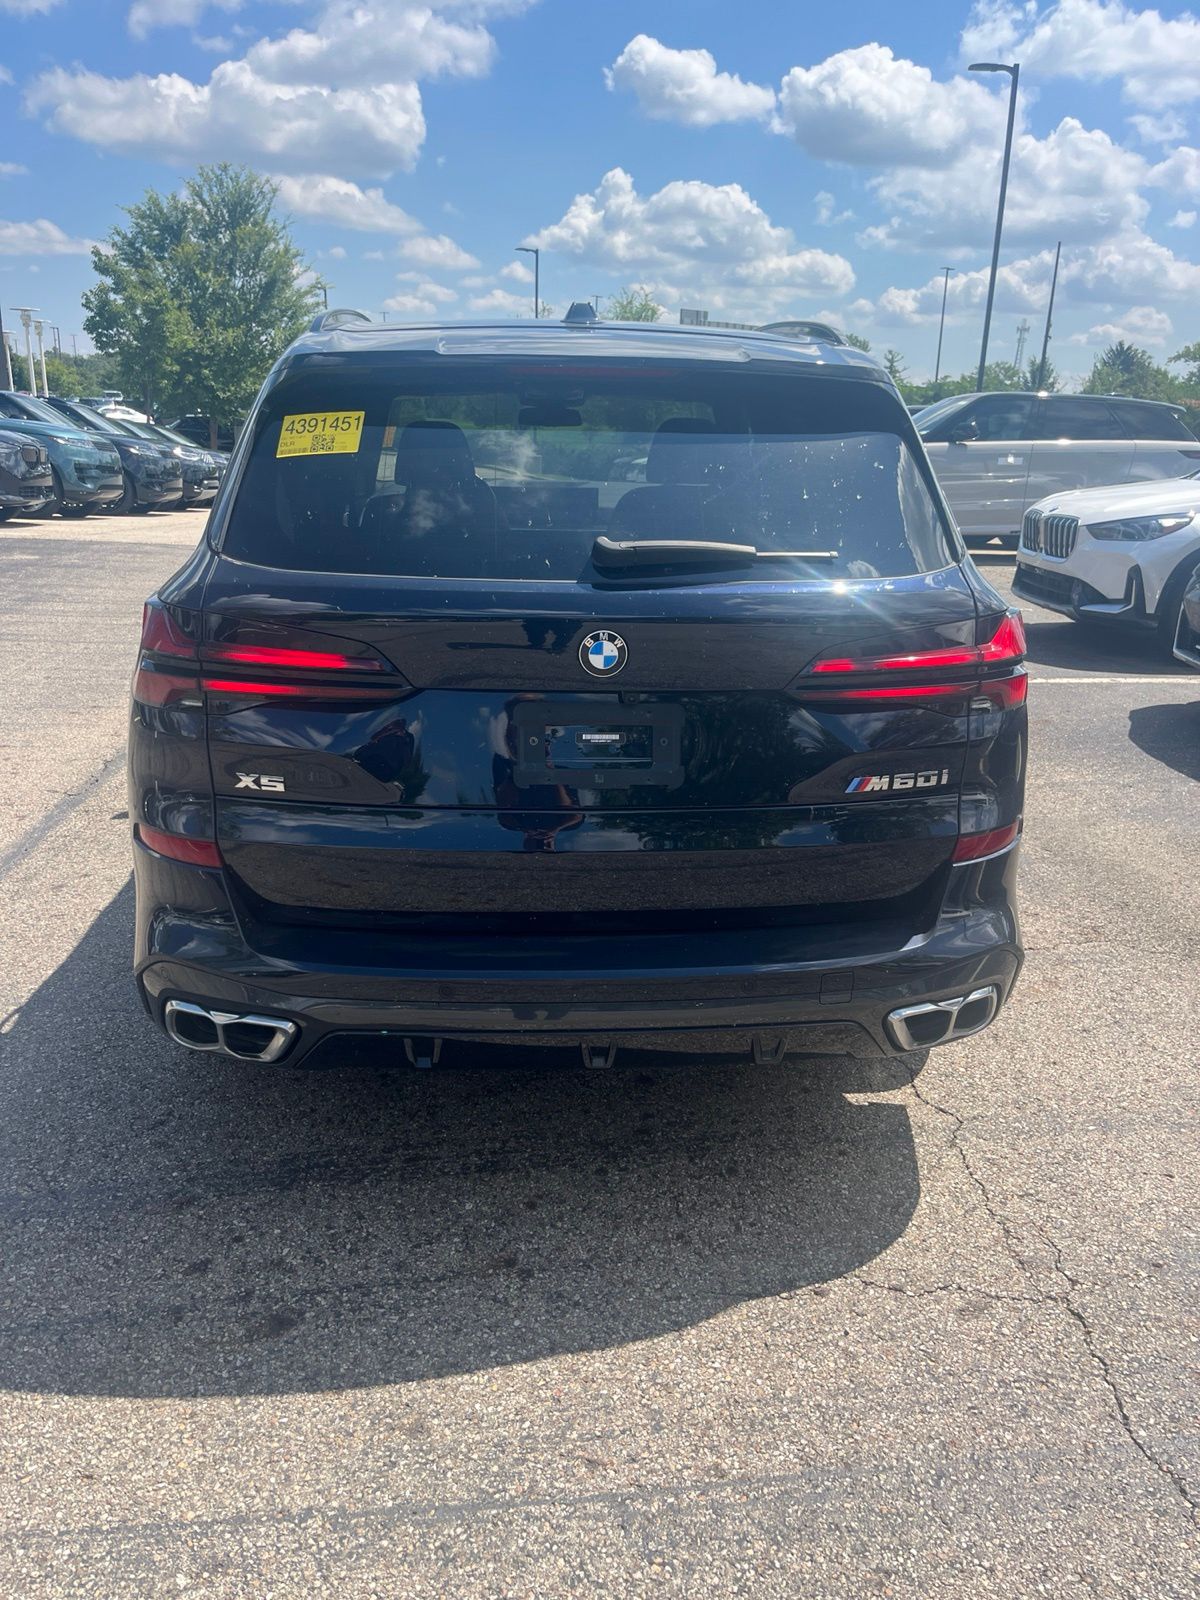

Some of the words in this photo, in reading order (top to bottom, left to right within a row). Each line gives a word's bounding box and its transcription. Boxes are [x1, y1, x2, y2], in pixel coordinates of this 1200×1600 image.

[285, 416, 361, 434] 4391451
[584, 632, 624, 648] BMW
[234, 772, 285, 792] X5
[862, 769, 949, 791] M60i
